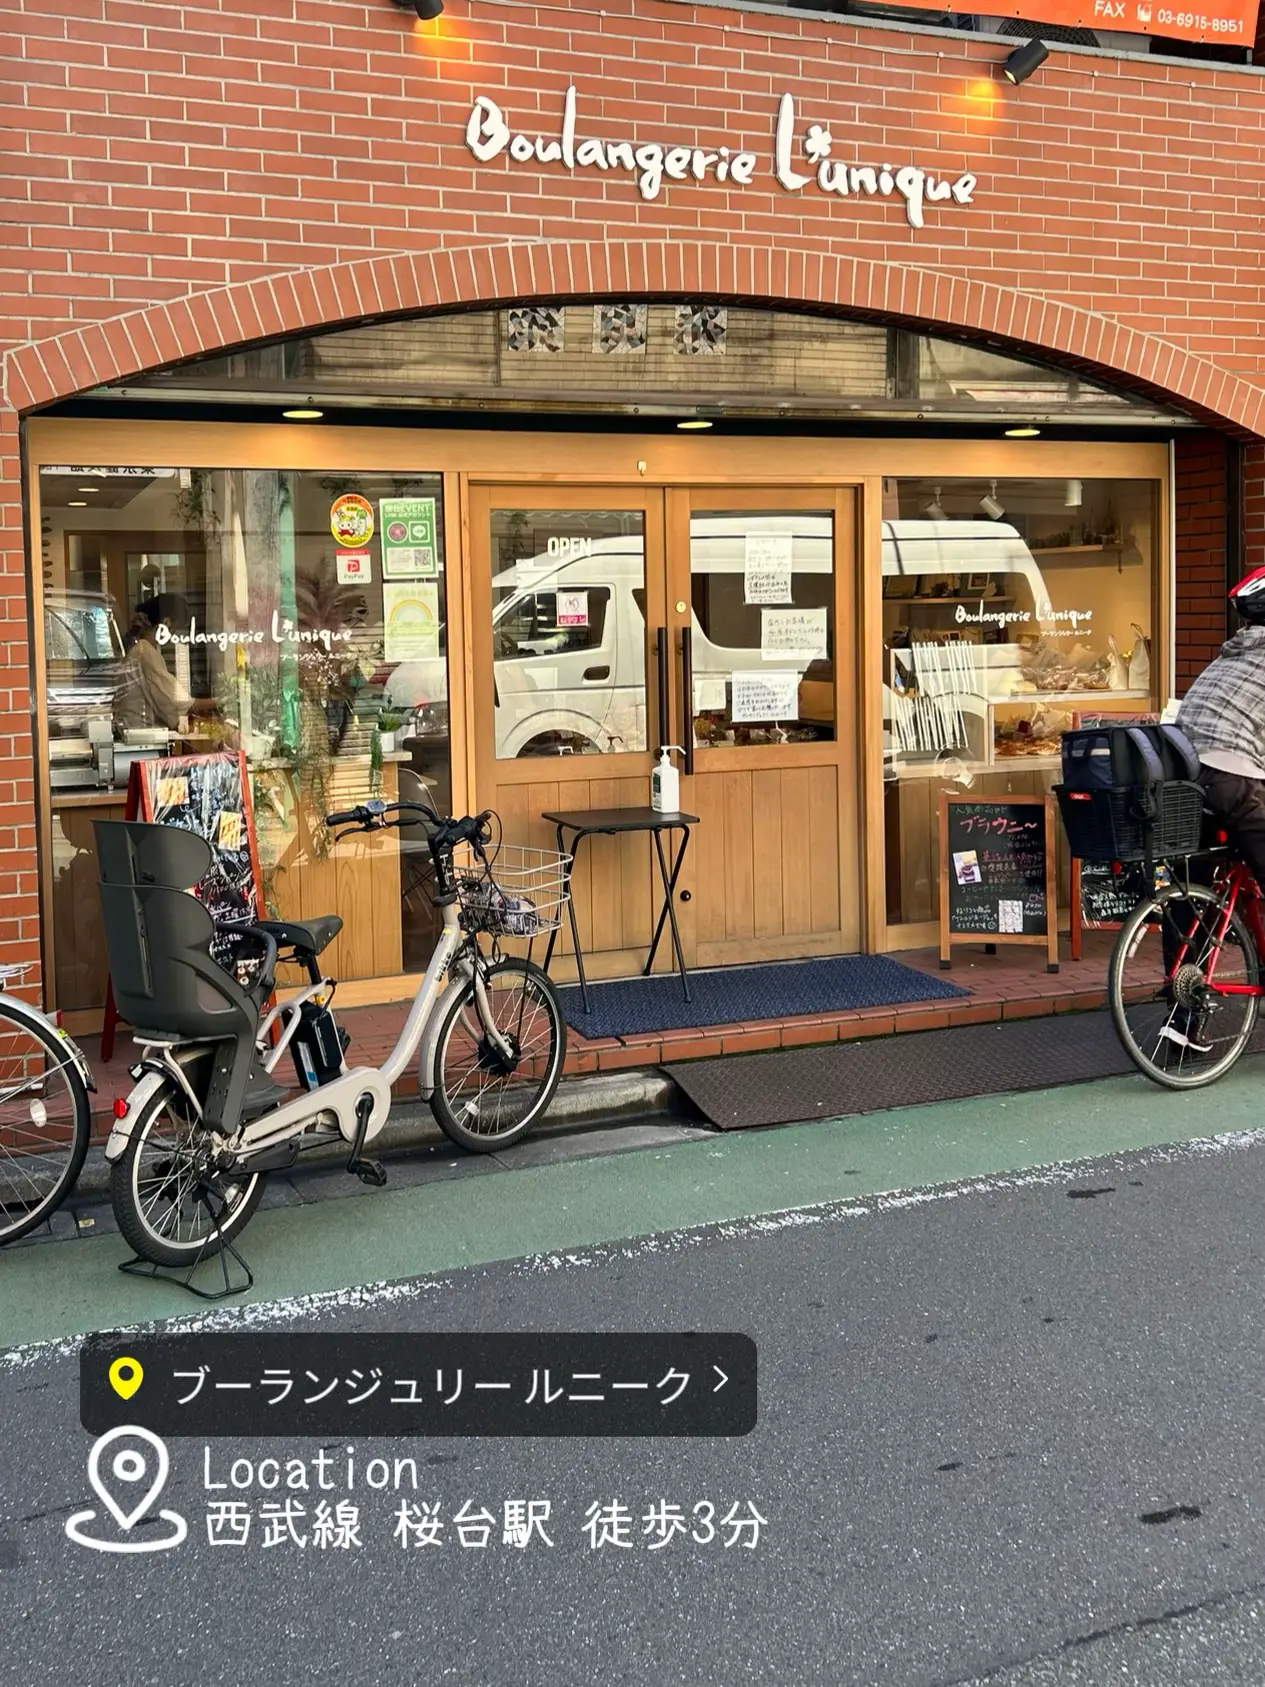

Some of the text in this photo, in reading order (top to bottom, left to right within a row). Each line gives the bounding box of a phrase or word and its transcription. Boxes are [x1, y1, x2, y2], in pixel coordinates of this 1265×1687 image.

[1094, 1, 1244, 34] FAX 03-6915-8951
[465, 85, 757, 200] Boulangerie
[547, 536, 593, 557] OPEN
[955, 599, 1031, 629] Boulangerie
[155, 616, 264, 651] Boulangerie
